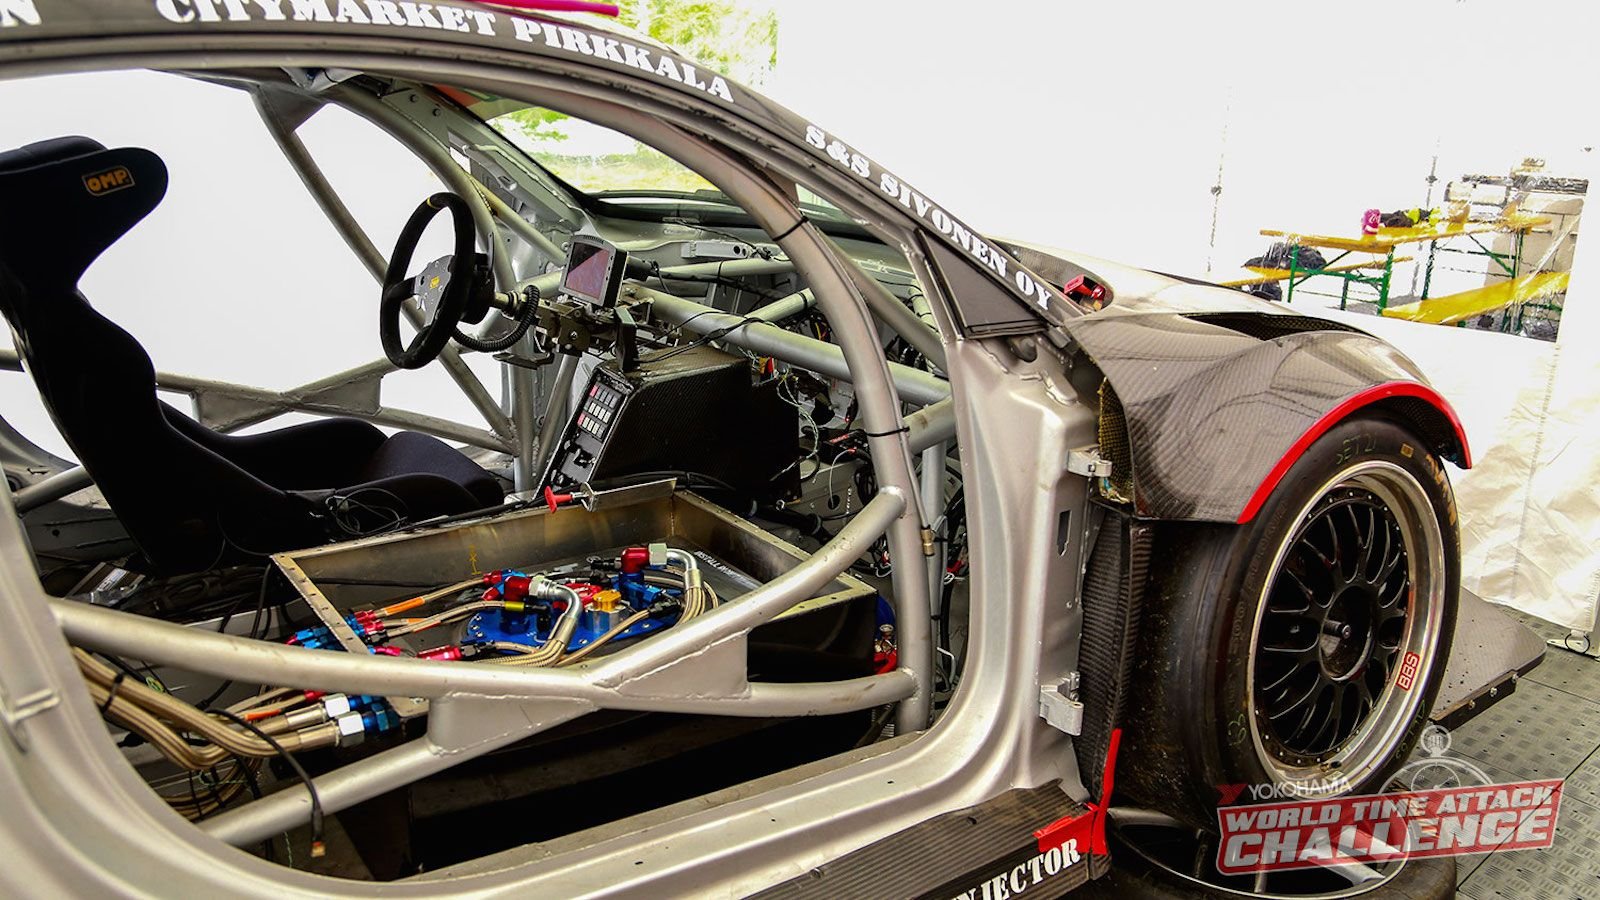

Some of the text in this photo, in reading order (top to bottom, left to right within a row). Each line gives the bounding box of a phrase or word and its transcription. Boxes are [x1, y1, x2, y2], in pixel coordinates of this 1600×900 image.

[156, 0, 735, 104] CITYMARKET PIRKKALA
[87, 170, 127, 192] OMP
[805, 125, 1052, 311] S&S SIVONEN OY
[1397, 653, 1419, 690] BBS
